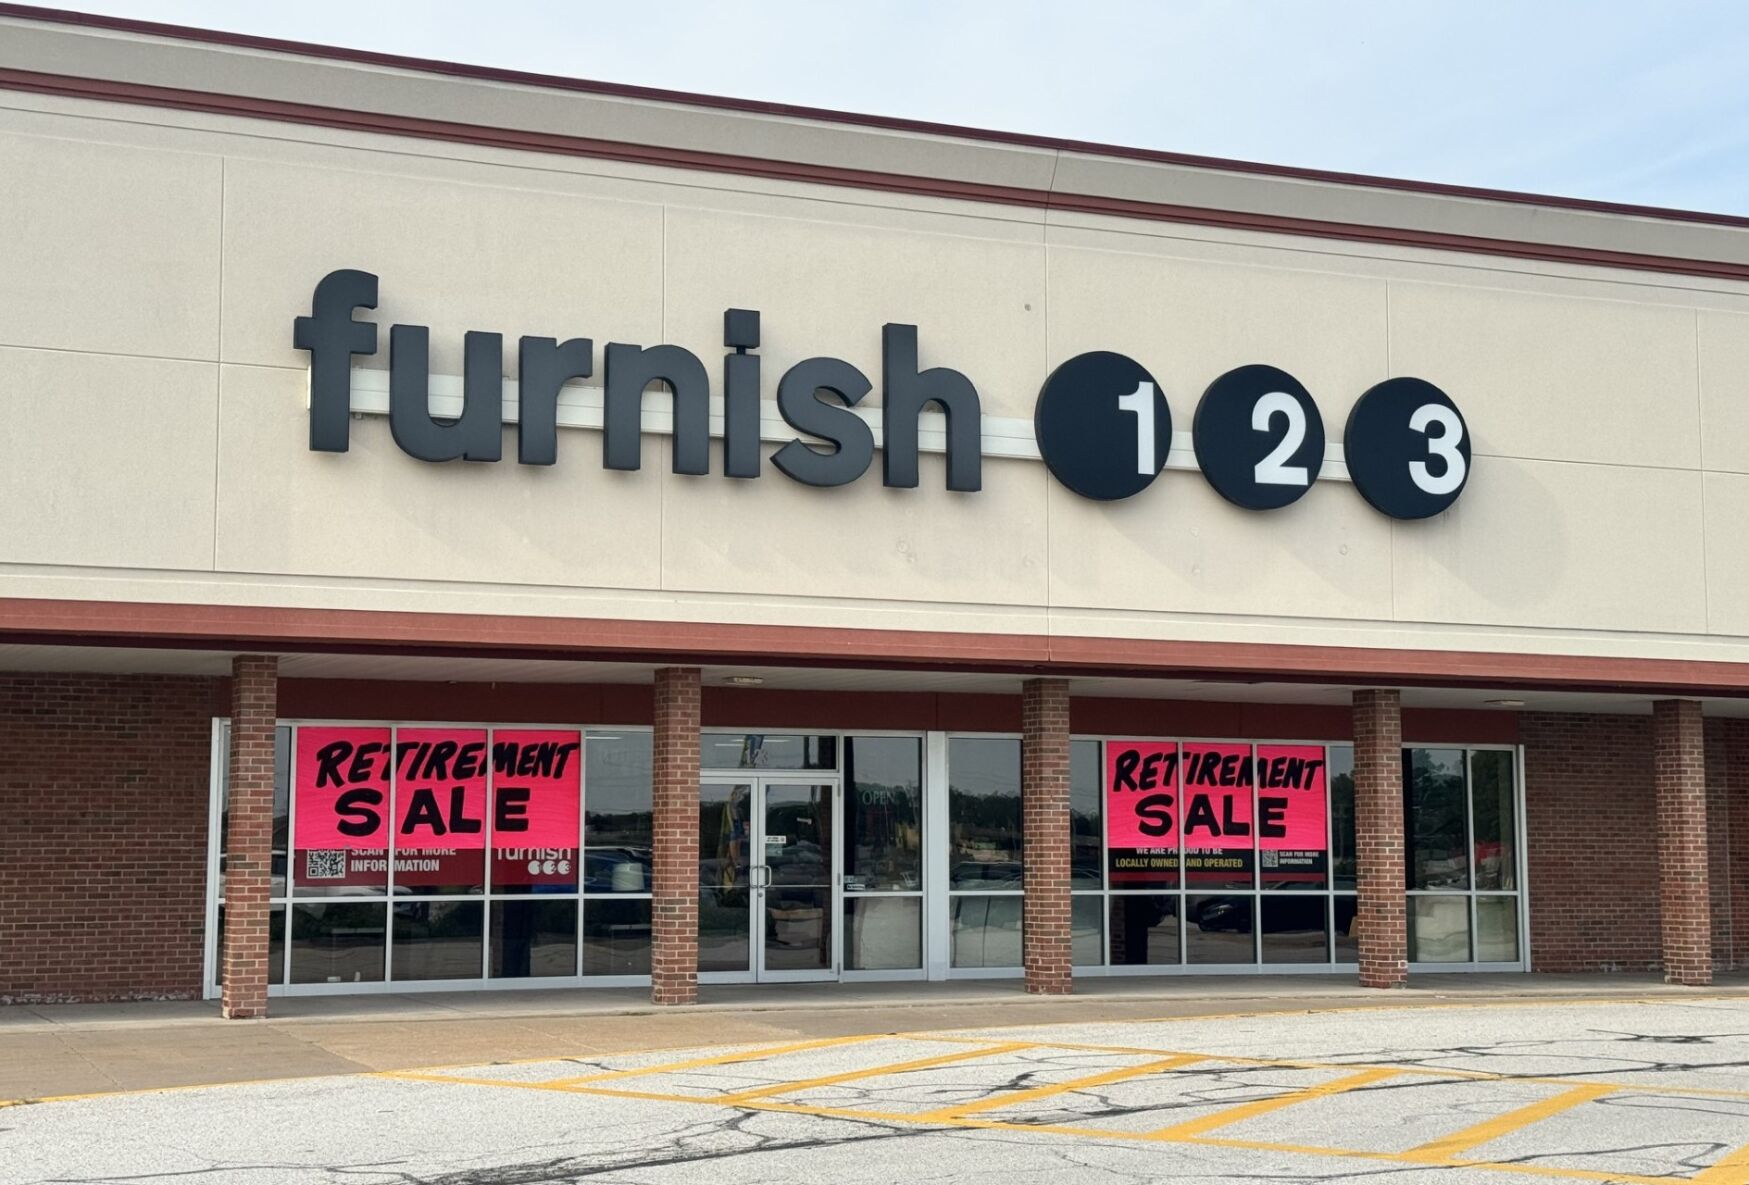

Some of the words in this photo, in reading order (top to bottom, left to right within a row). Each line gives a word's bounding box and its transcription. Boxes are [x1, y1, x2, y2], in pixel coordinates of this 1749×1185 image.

[293, 268, 982, 492] furnish
[1118, 381, 1155, 475] 1
[1251, 391, 1309, 486] 2
[1408, 403, 1467, 495] 3
[315, 740, 580, 788] RETIREMENT
[1113, 749, 1323, 792] RETIREMENT
[334, 786, 531, 837] SALE
[1135, 793, 1288, 838] SALE
[351, 859, 440, 872] INFORMATION
[1115, 858, 1149, 868] LOCALLY
[1151, 858, 1179, 868] OWNED
[1185, 858, 1203, 868] AND
[1204, 858, 1243, 868] OPERATED
